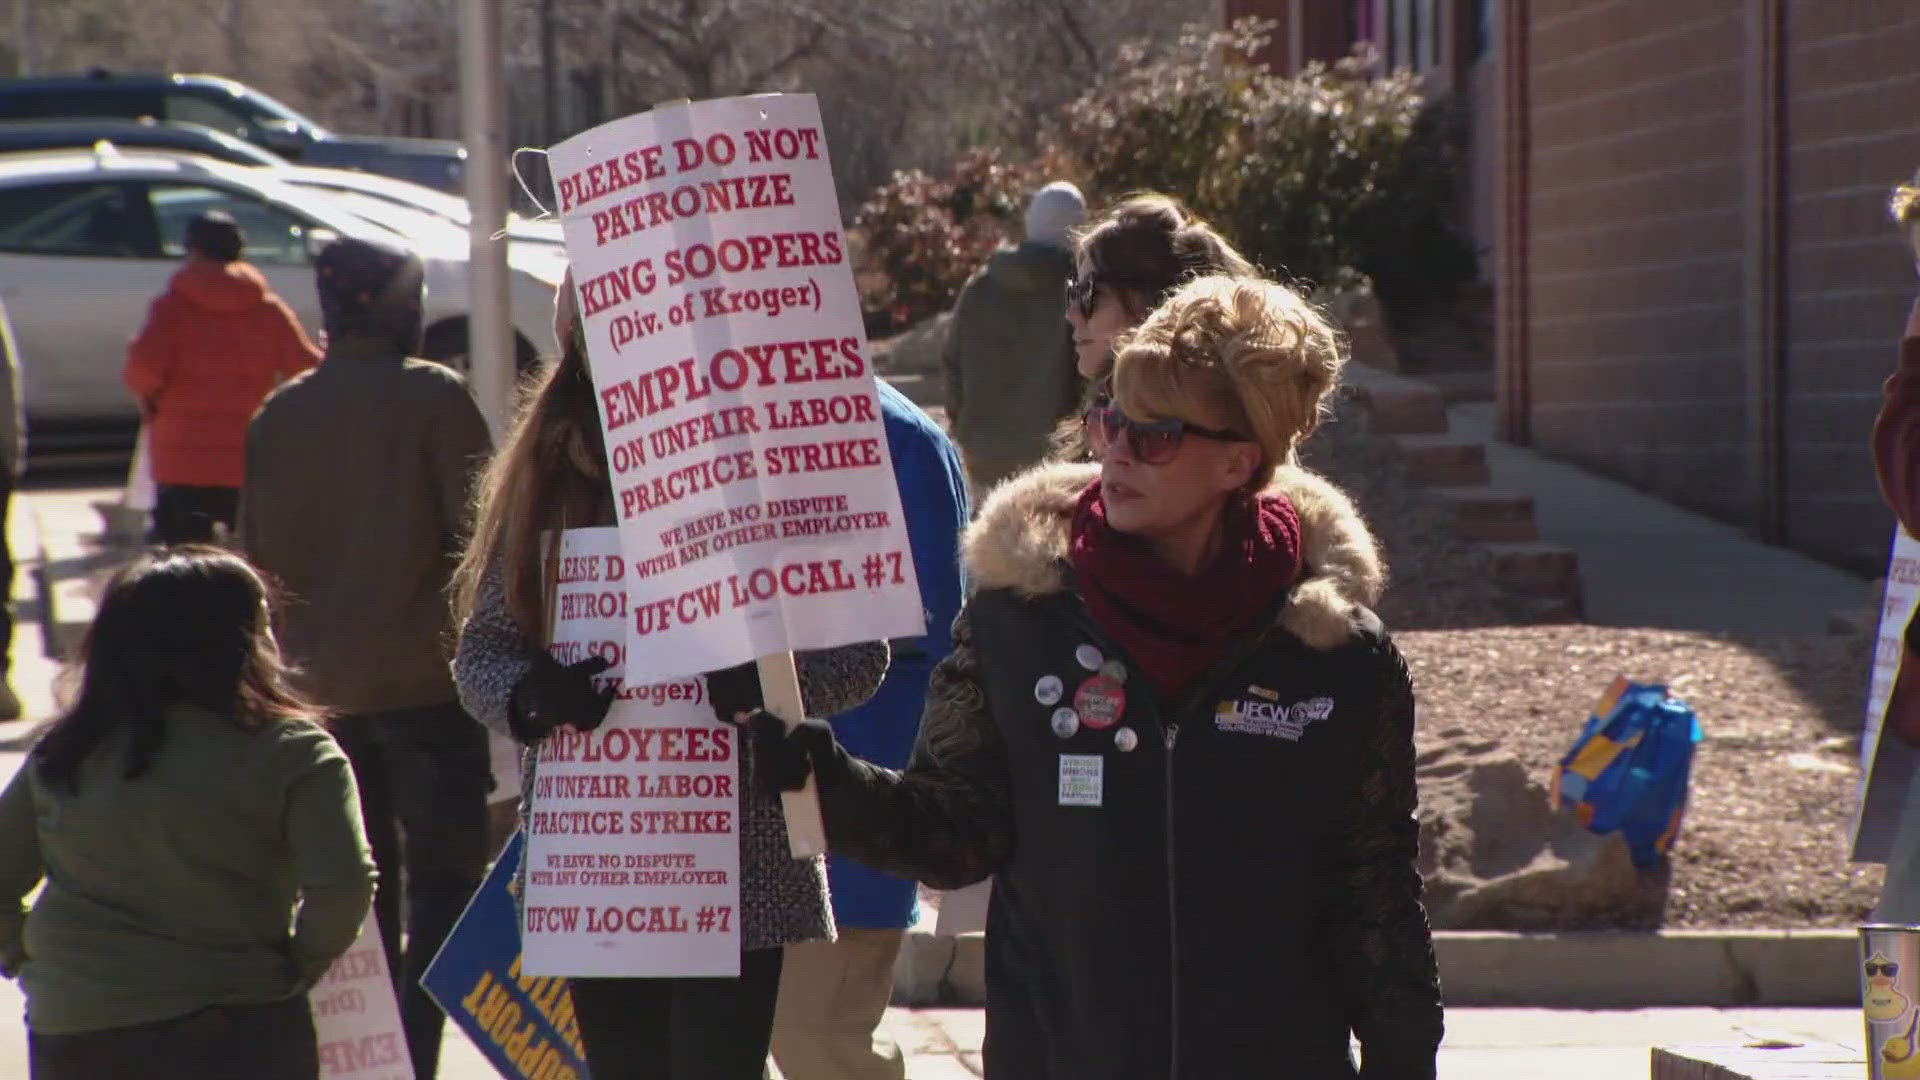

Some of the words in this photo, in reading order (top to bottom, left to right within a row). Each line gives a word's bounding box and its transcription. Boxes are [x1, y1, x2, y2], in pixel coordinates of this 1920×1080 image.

[559, 145, 667, 212] PLEASE
[672, 132, 736, 173] DO
[744, 127, 820, 163] NOT
[591, 173, 795, 247] PATRONIZE
[579, 258, 657, 318] KING
[664, 231, 842, 287] SOOPERS
[609, 309, 664, 354] (Div.
[669, 294, 696, 327] of
[701, 278, 822, 318] Kroger)
[600, 336, 865, 432] EMPLOYEES
[612, 436, 647, 474] ON
[650, 405, 761, 460] UNFAIR
[764, 394, 877, 431] LABOR
[620, 450, 758, 520] PRACTICE
[764, 438, 882, 476] STRIKE
[636, 551, 678, 580] WITH
[679, 539, 710, 564] ANY
[712, 524, 777, 552] OTHER
[782, 511, 891, 537] EMPLOYER
[659, 523, 684, 550] WE
[685, 511, 727, 541] HAVE
[729, 504, 760, 524] NO
[767, 495, 848, 520] DISPUTE
[561, 590, 627, 620] PATRO
[634, 580, 722, 636] UFCW
[728, 558, 855, 608] LOCAL
[861, 550, 905, 590] #7
[1232, 699, 1290, 723] UFCW
[539, 727, 732, 763] EMPLOYEES
[535, 775, 552, 799] ON
[556, 775, 631, 799] UNFAIR
[637, 774, 733, 799] LABOR
[532, 811, 624, 836] PRACTICE
[630, 810, 732, 835] STRIKE
[531, 871, 554, 886] WITH
[556, 871, 577, 886] ANY
[580, 871, 630, 886] OTHER
[633, 871, 728, 886] EMPLOYER
[547, 854, 561, 869] WE
[563, 854, 595, 869] HAVE
[598, 854, 621, 869] NO
[625, 853, 696, 868] DISPUTE
[527, 906, 580, 933] UFCW
[586, 906, 688, 934] LOCAL
[696, 905, 732, 934] #7
